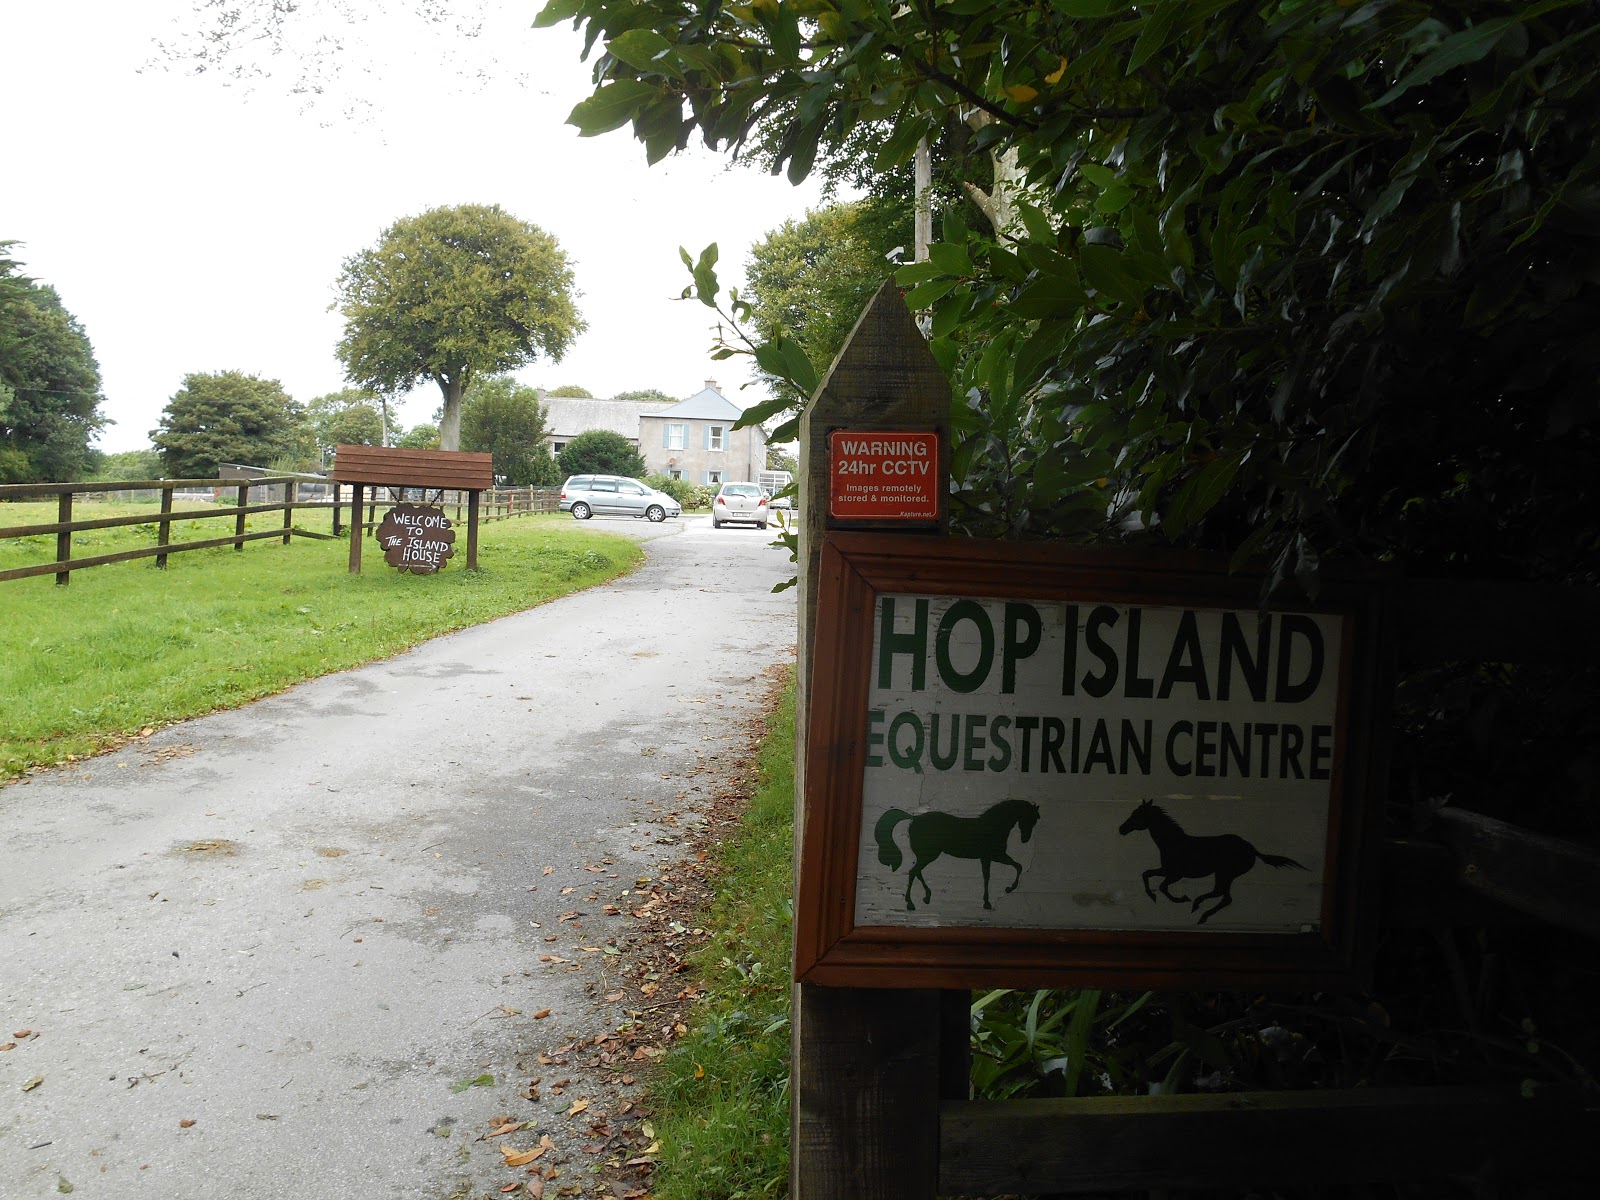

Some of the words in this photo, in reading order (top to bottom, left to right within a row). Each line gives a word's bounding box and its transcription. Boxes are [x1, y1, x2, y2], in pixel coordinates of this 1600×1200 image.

[841, 440, 927, 456] WARNING
[838, 460, 877, 475] 24hr
[881, 460, 930, 475] CCTV
[846, 483, 879, 493] Images
[882, 484, 922, 494] remotely
[838, 494, 868, 502] stored
[870, 494, 877, 502] &
[880, 494, 930, 503] monitored.
[393, 513, 447, 528] WELCOME
[406, 527, 423, 535] TO
[385, 535, 402, 546] THE
[406, 537, 448, 552] ISLAND
[403, 547, 441, 563] HOUSE
[877, 597, 1042, 695] HOP
[1061, 604, 1325, 704] ISLAND
[865, 709, 1154, 776] EQUESTRIAN
[1165, 719, 1333, 781] CENTRE
